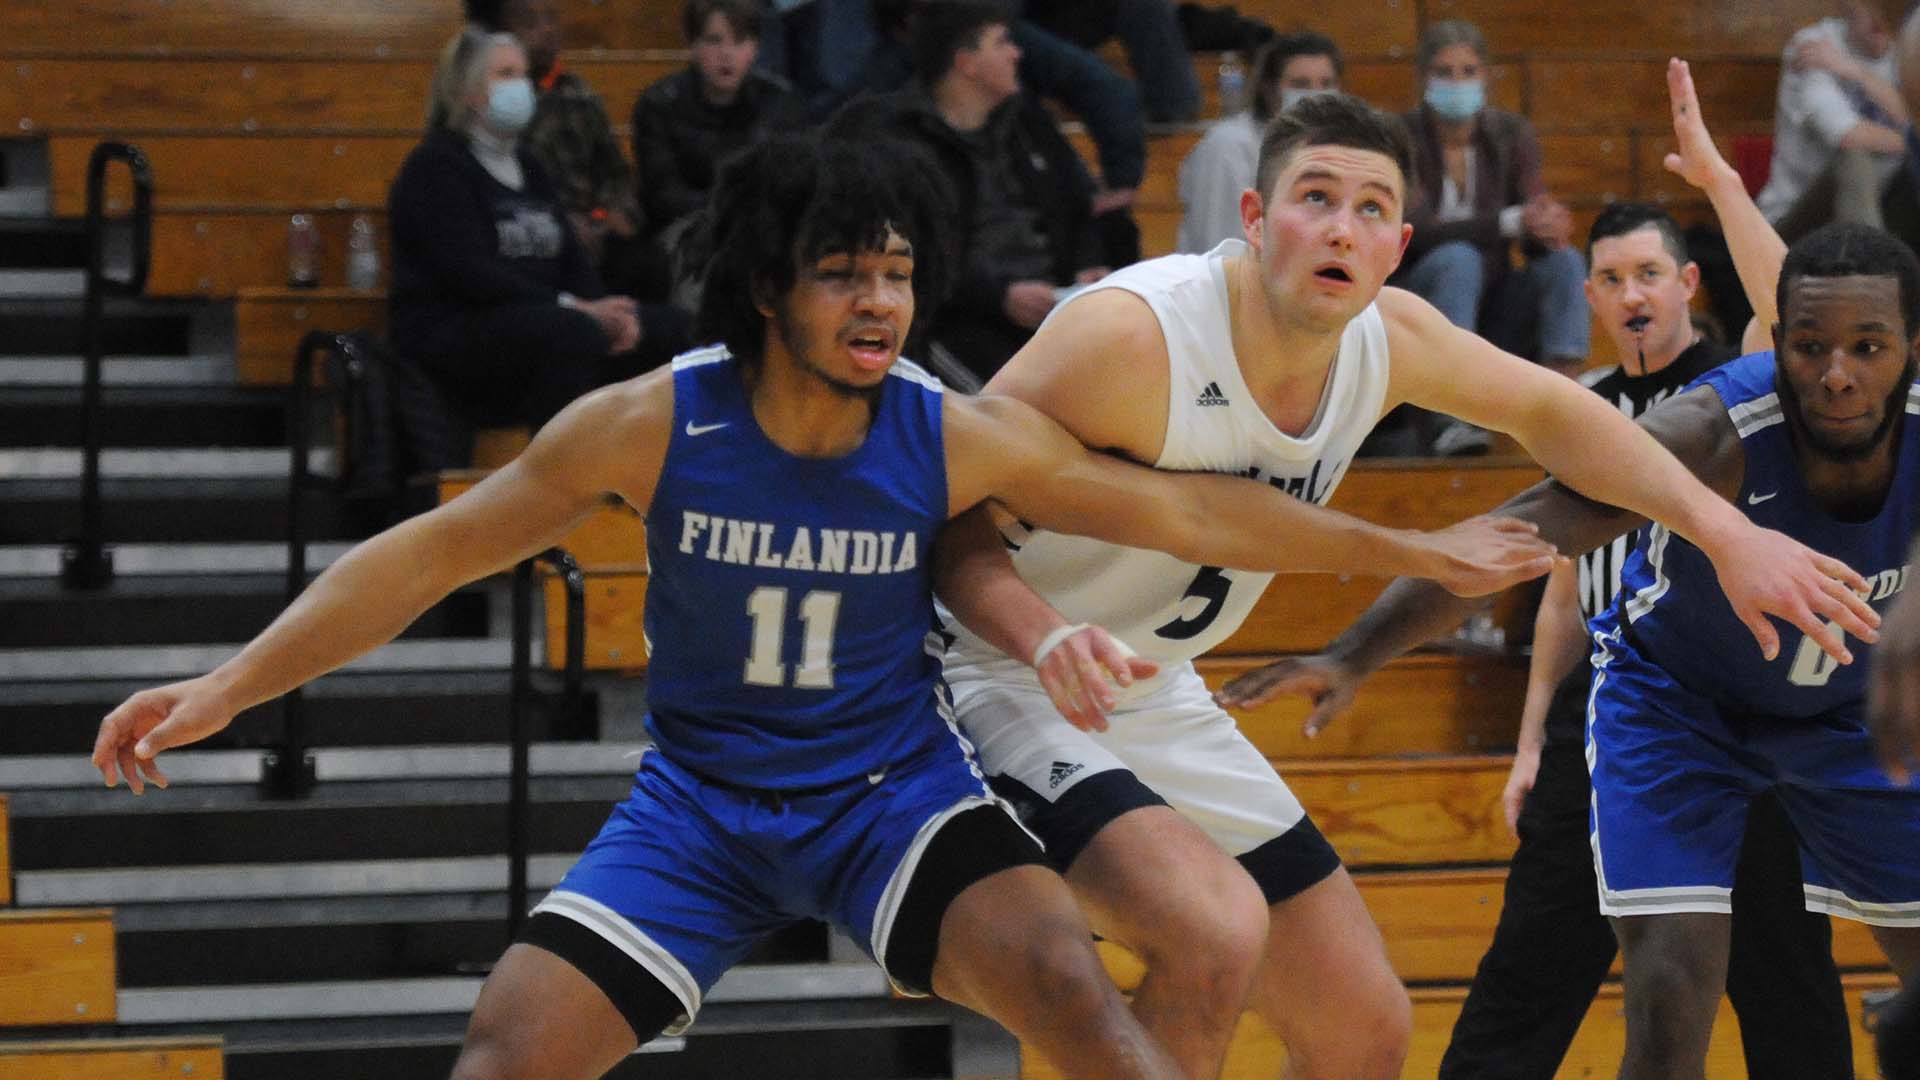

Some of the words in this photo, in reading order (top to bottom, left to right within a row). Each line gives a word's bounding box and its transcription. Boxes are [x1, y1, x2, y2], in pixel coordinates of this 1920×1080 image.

[679, 510, 917, 575] FINLANDIA
[743, 586, 842, 689] 11
[1049, 763, 1085, 789] adidas
